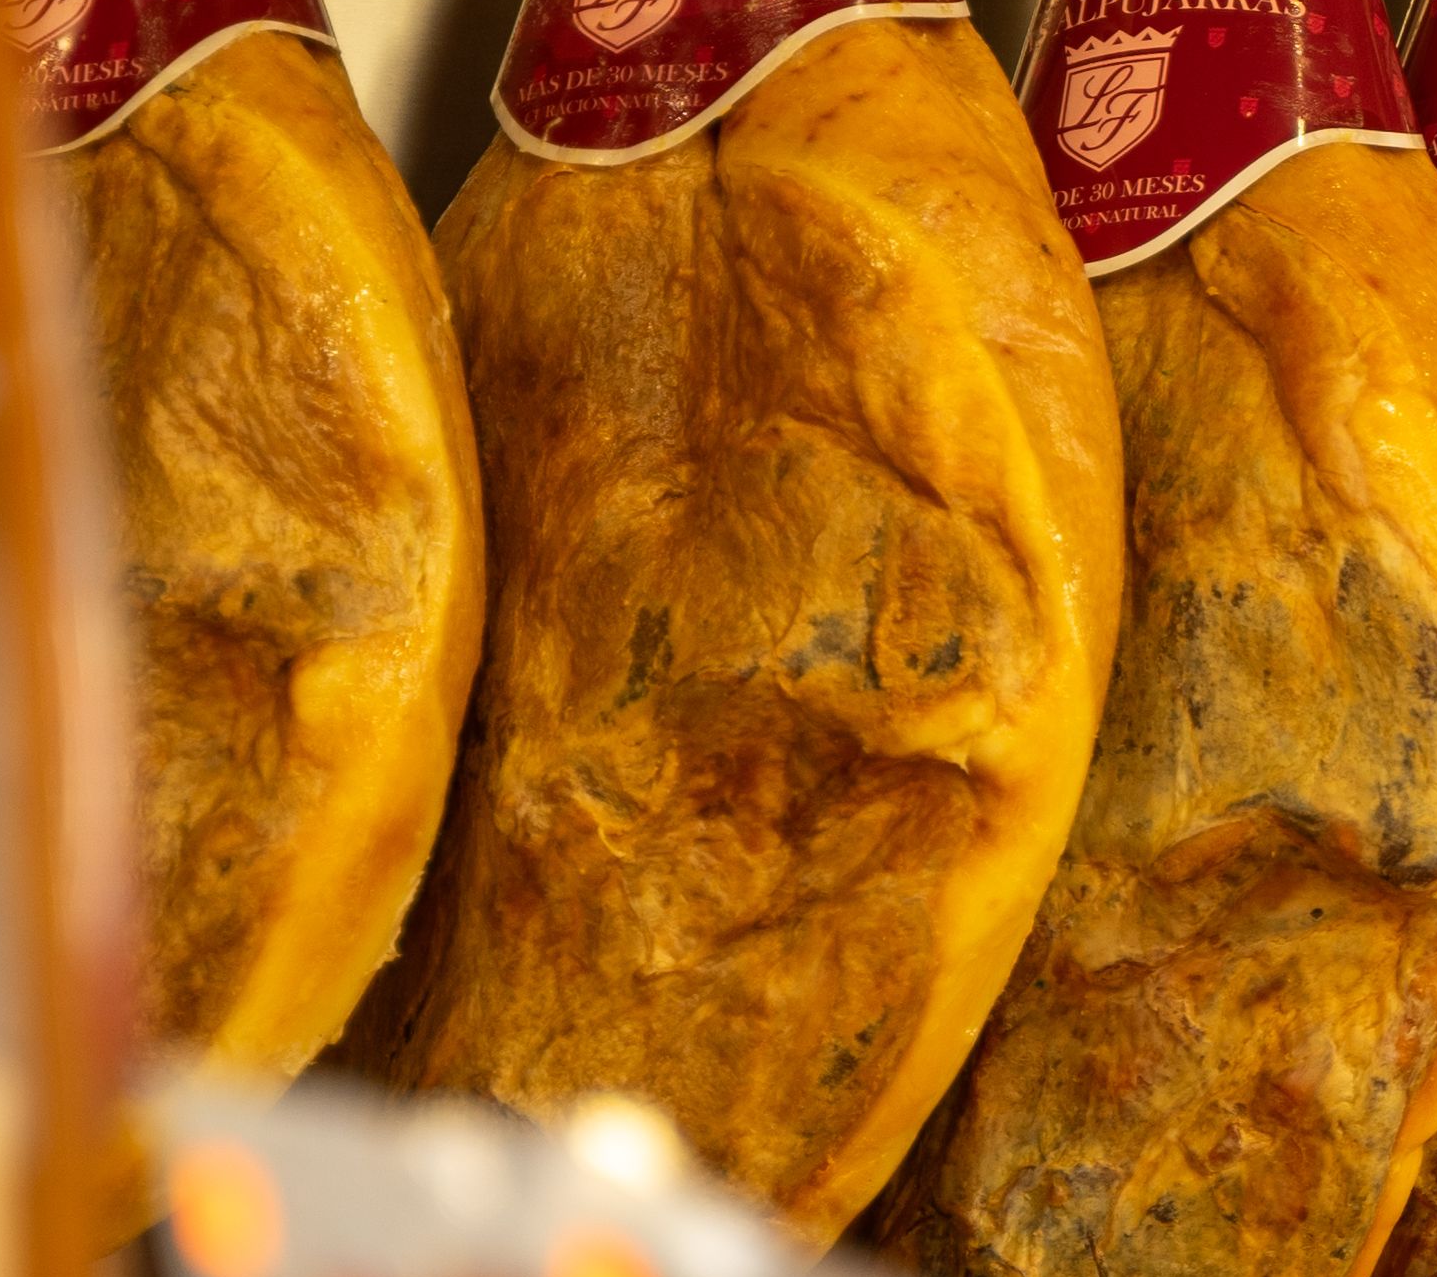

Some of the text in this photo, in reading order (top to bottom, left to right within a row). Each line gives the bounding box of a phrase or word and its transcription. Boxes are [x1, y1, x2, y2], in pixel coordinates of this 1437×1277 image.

[53, 57, 148, 85] MESES
[566, 67, 601, 91] DE
[641, 60, 730, 84] MESES
[1089, 181, 1115, 203] 30
[1120, 174, 1207, 199] MESES
[1096, 204, 1183, 225] NATURAL
